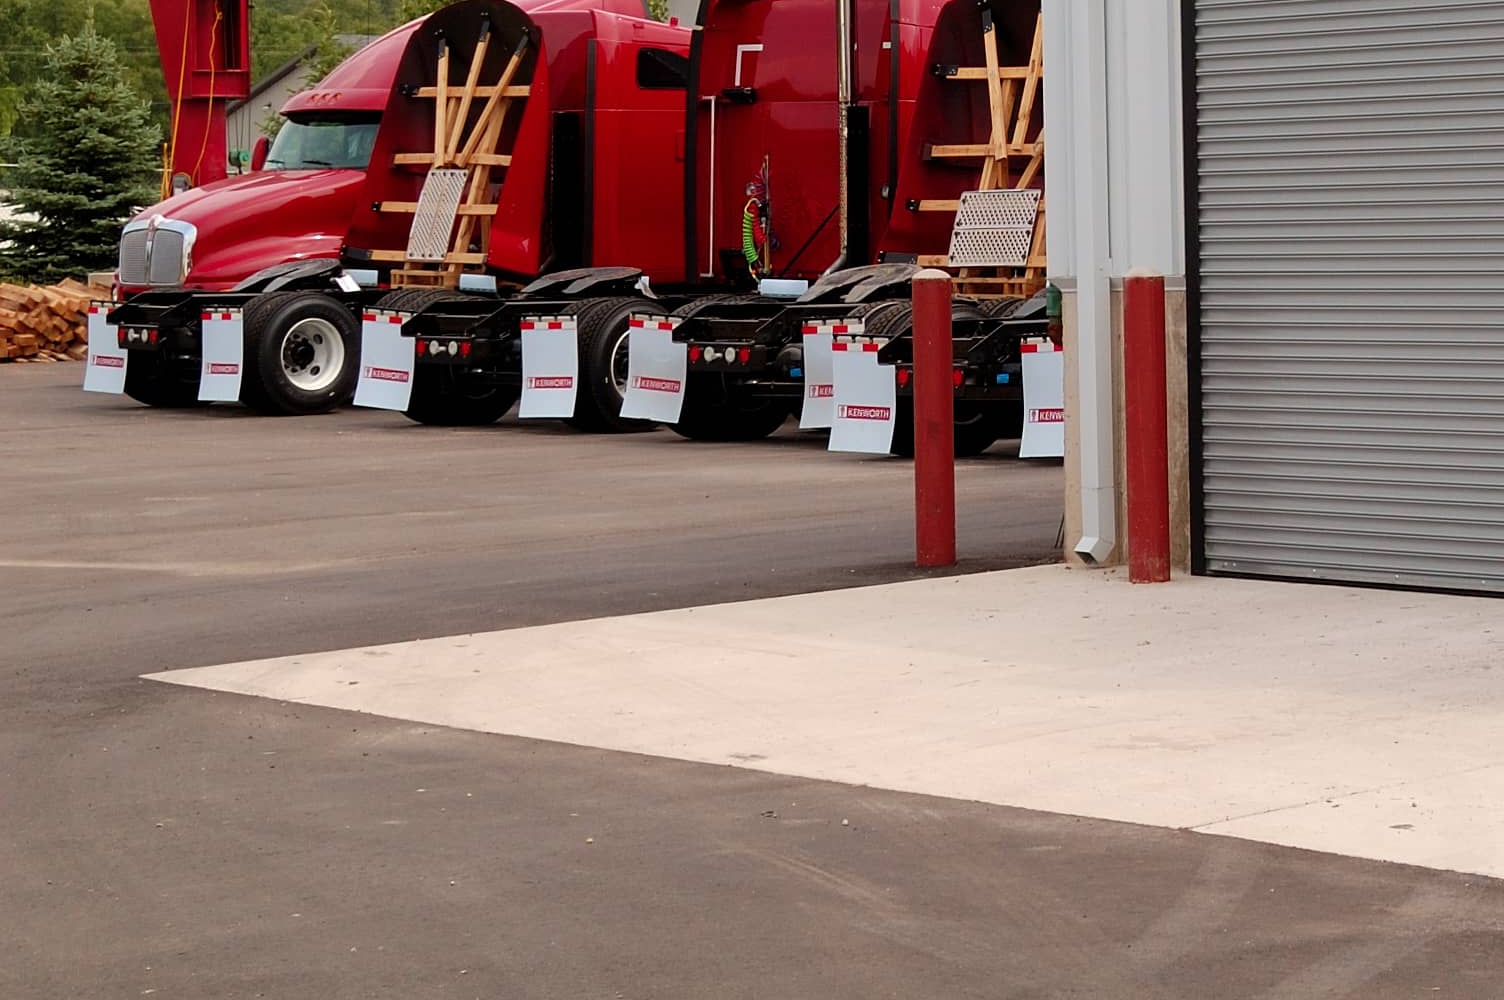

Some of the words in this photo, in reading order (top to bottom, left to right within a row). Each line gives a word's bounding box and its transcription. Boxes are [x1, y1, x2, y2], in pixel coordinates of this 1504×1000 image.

[641, 379, 680, 391] KENWORTH
[847, 407, 889, 419] KENWORTH
[1039, 411, 1064, 421] KENW
